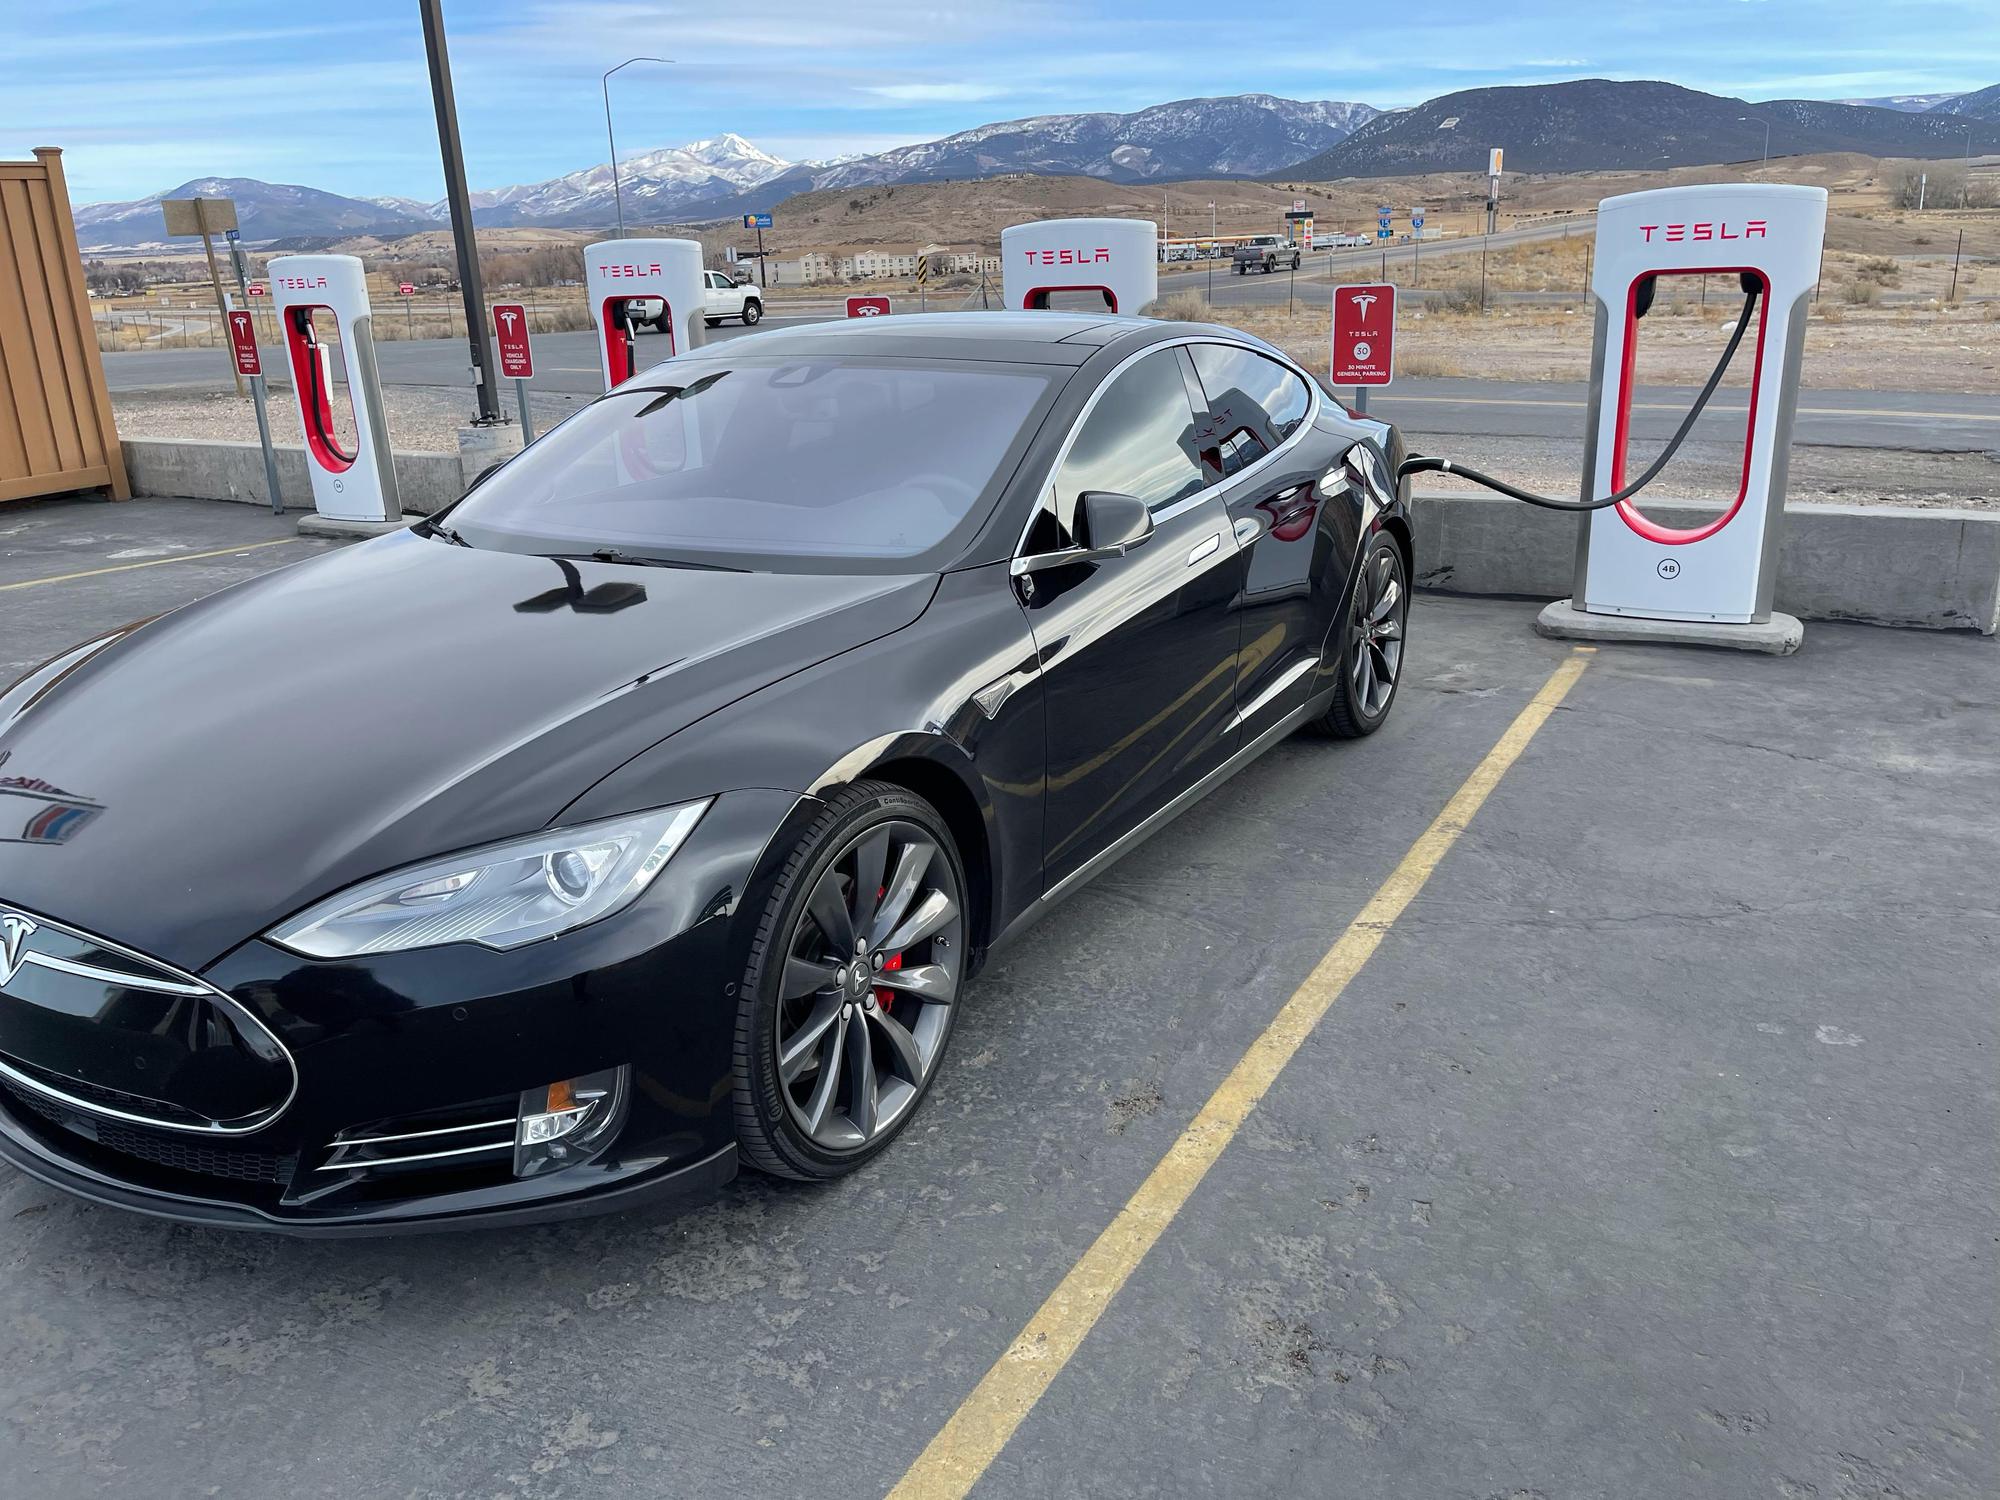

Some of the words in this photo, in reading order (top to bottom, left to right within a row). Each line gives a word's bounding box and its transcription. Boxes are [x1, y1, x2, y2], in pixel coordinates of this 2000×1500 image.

[1639, 220, 1767, 243] TESLA
[1024, 248, 1109, 266] TESLA
[599, 263, 661, 278] TESLA
[278, 277, 327, 289] TESLA
[1356, 347, 1368, 355] 30
[1661, 565, 1675, 573] 4B
